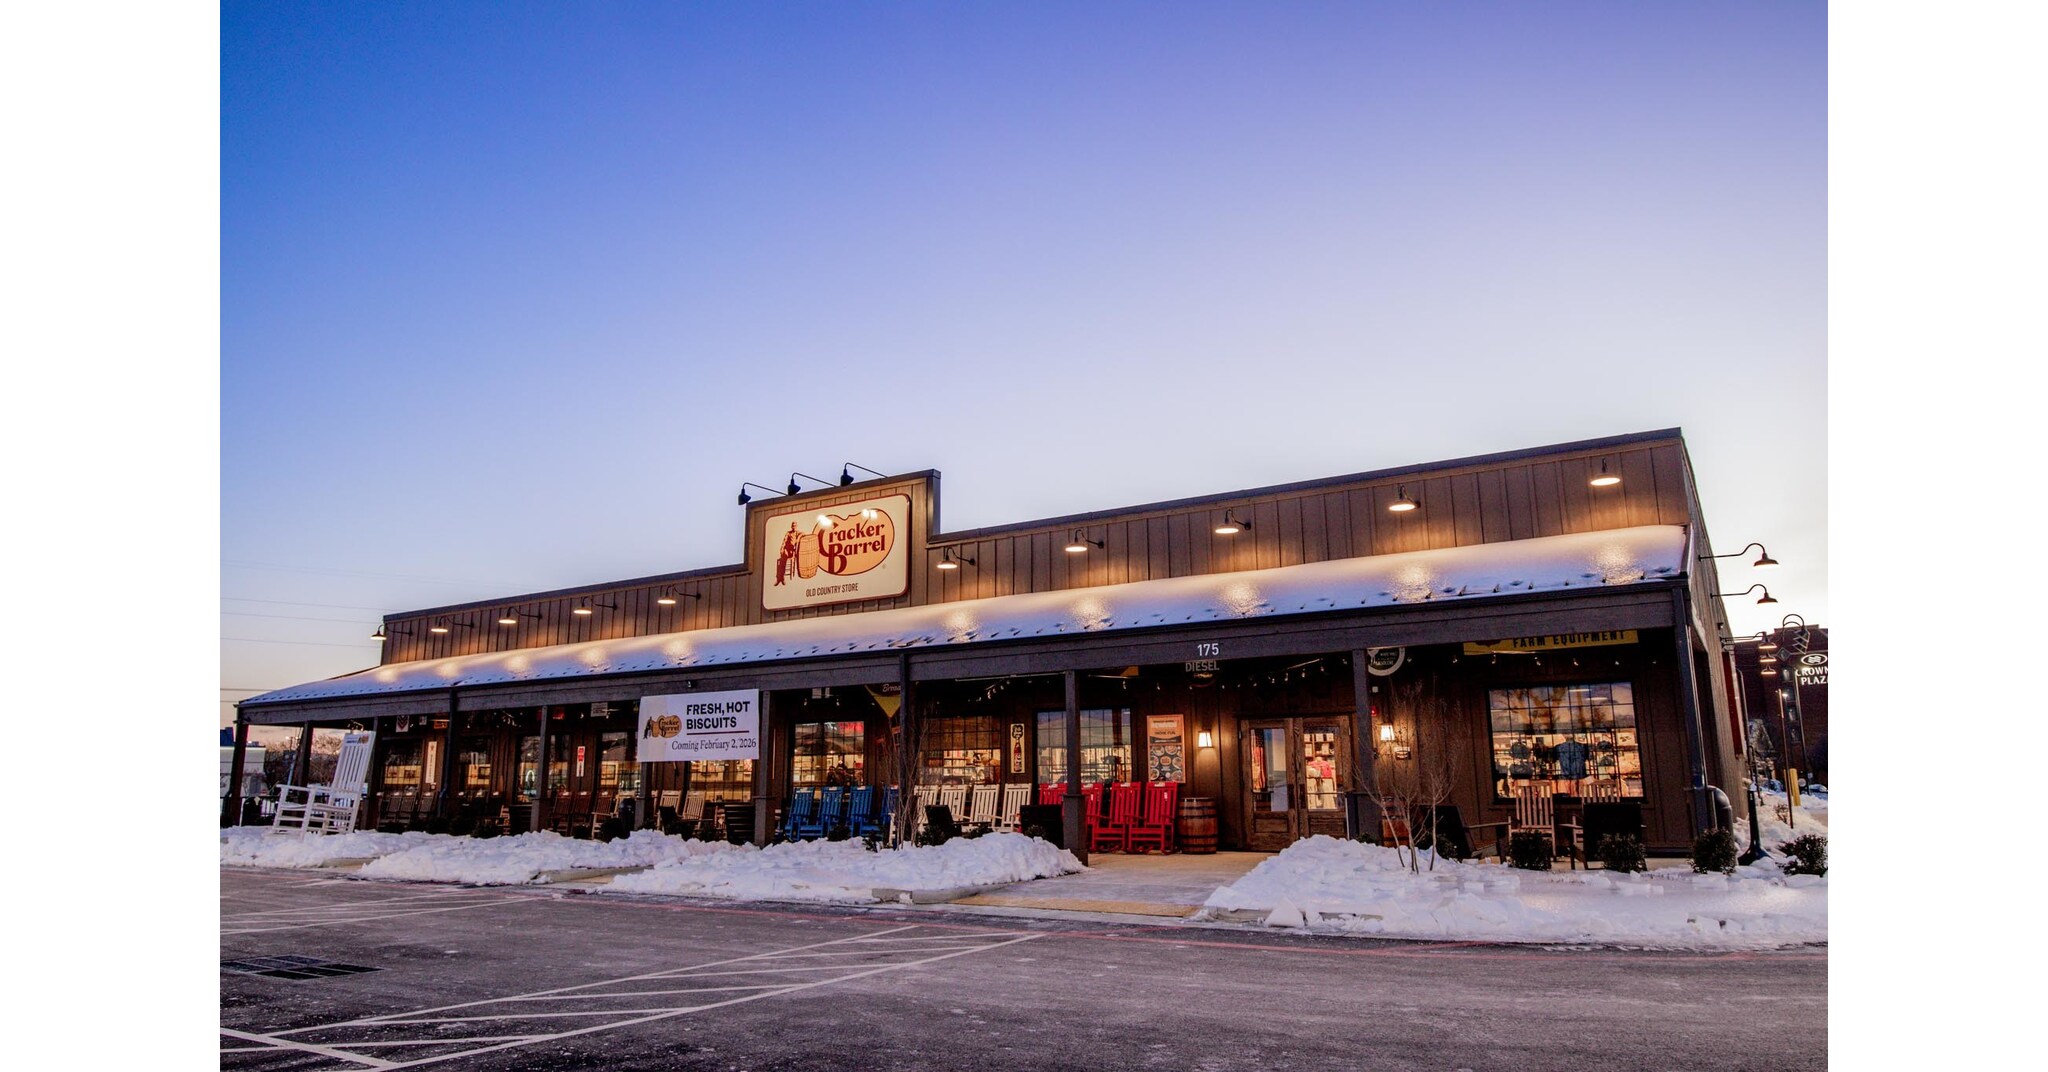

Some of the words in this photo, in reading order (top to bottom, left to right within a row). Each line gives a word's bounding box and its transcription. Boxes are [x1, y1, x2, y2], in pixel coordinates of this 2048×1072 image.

[818, 518, 885, 557] Cracker
[828, 536, 886, 574] Barrel
[806, 588, 816, 597] OLD
[817, 585, 841, 596] COUNTRY
[842, 583, 859, 593] STORE
[1513, 636, 1546, 648] FARM
[1553, 631, 1625, 645] EQUIPMENT
[1197, 643, 1219, 656] 175
[1185, 660, 1220, 672] DIESEL
[1800, 675, 1828, 685] PLAZ
[686, 703, 724, 716] FRESH,
[726, 701, 750, 713] HOT
[686, 716, 737, 730] BISCUITS
[671, 740, 699, 752] Coming
[700, 738, 730, 751] February
[731, 739, 738, 749] 2,
[740, 737, 757, 748] 2026
